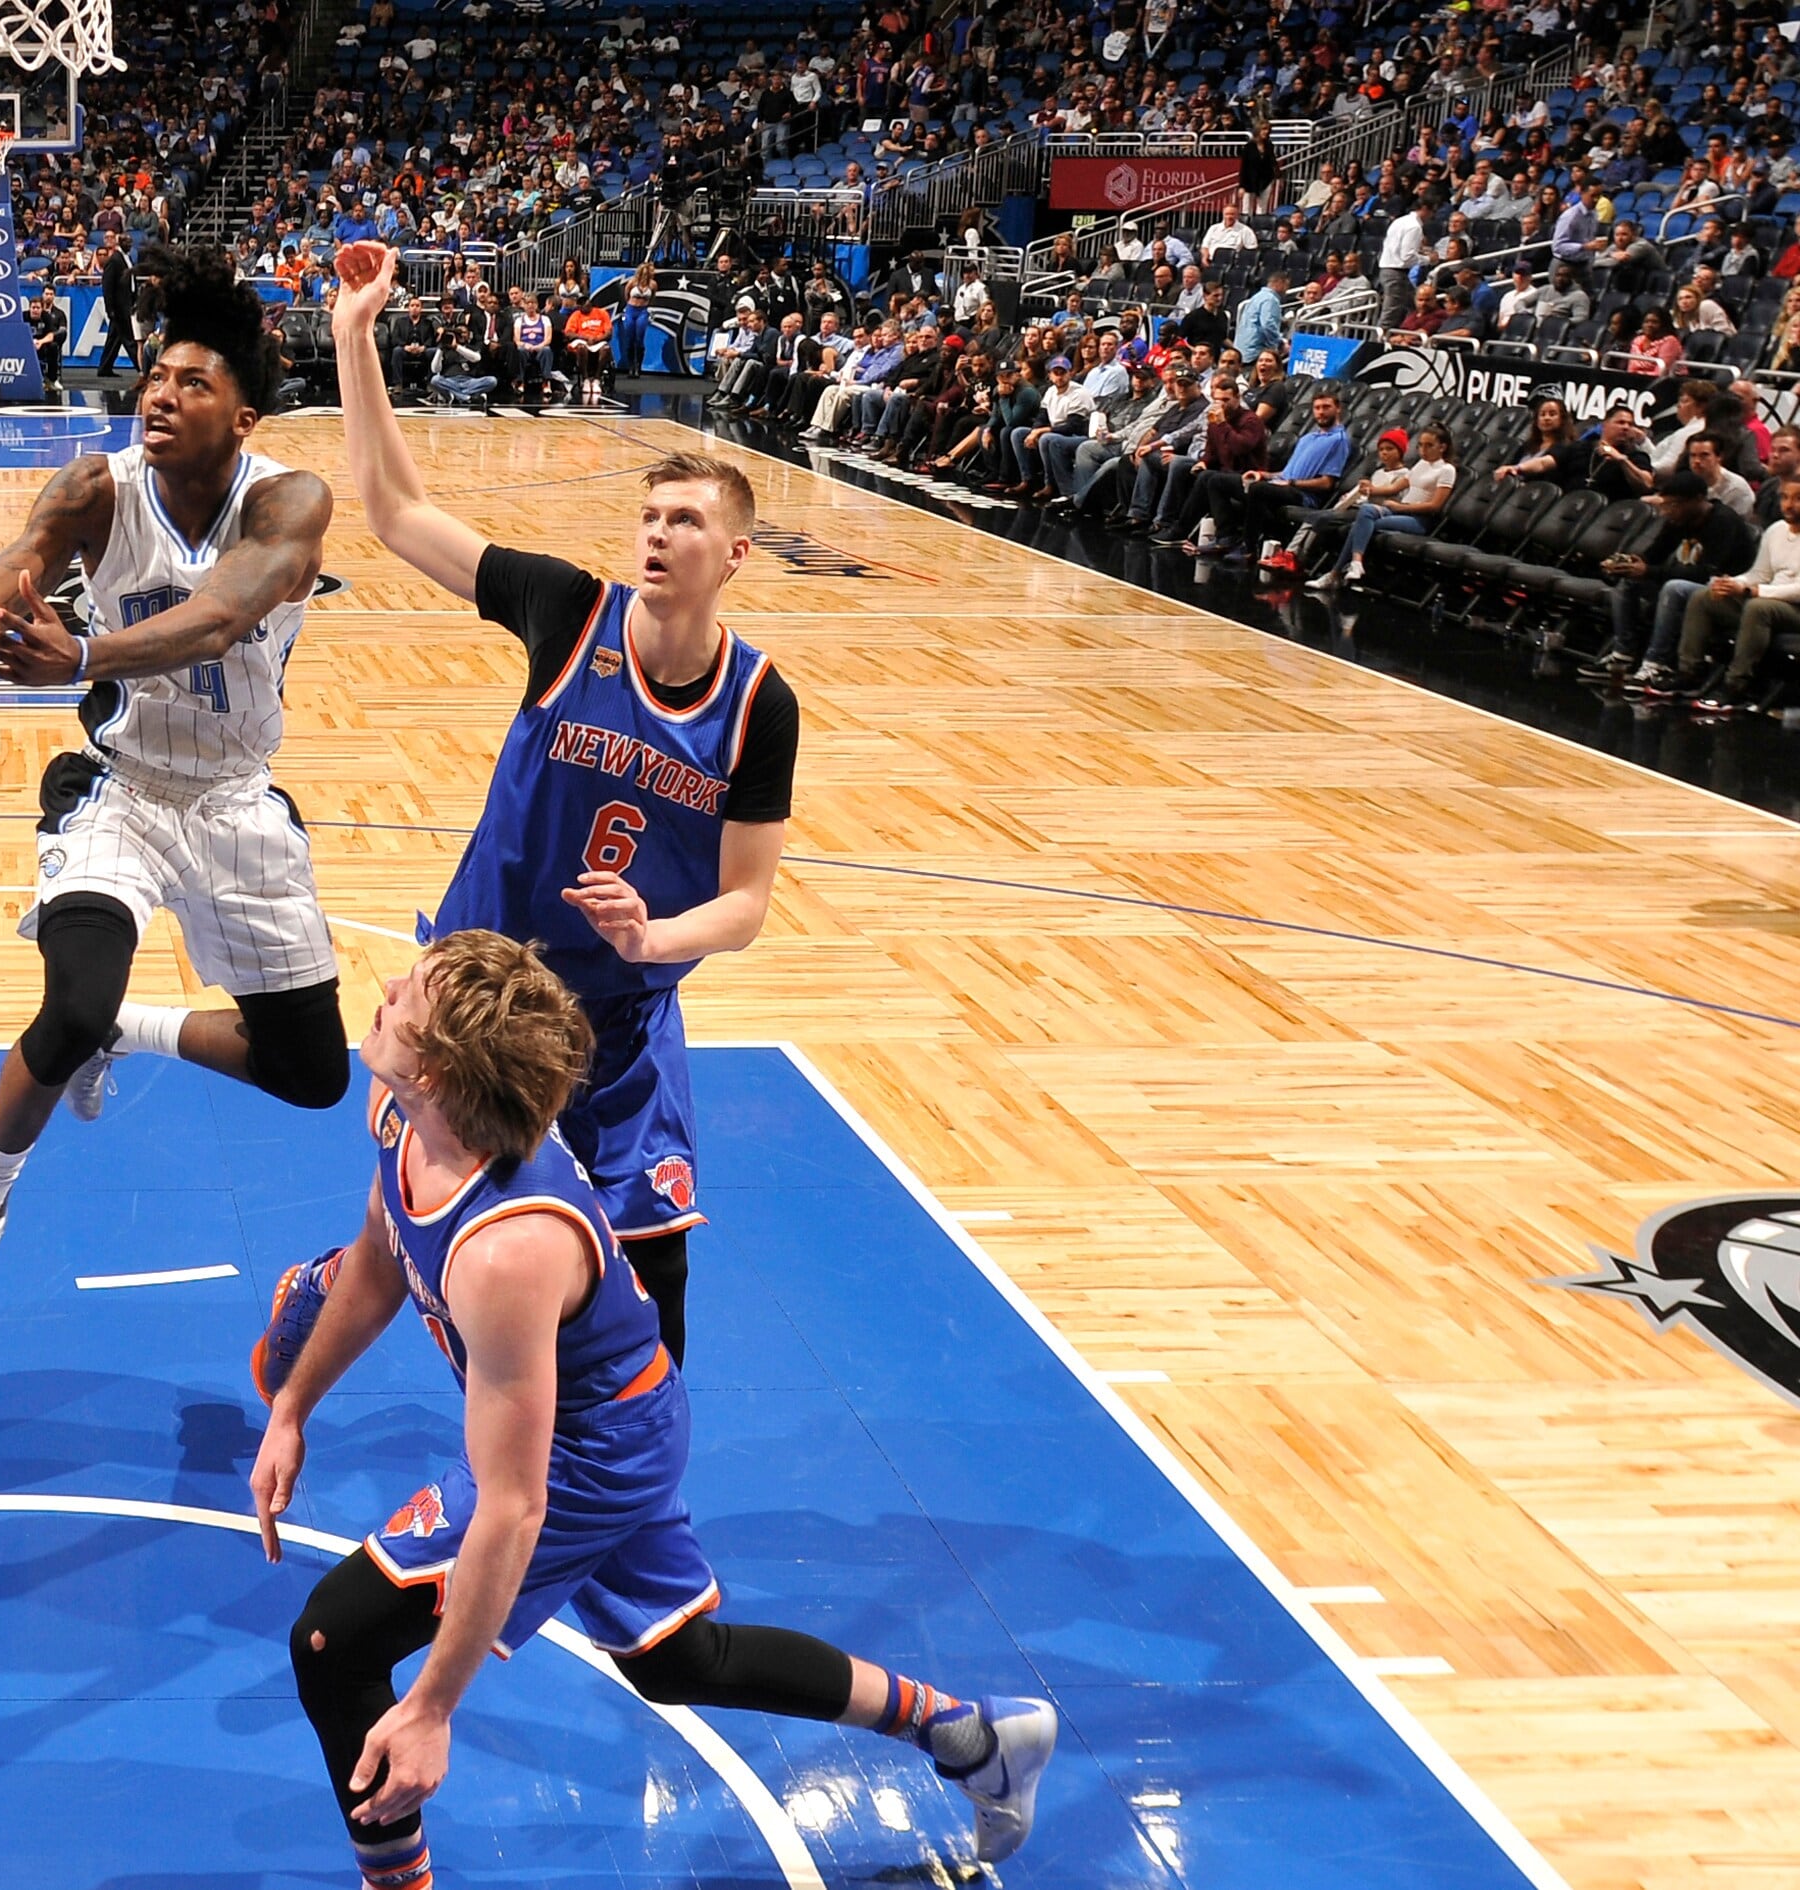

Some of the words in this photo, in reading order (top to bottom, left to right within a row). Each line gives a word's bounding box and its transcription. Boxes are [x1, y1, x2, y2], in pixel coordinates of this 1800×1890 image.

[1142, 169, 1206, 186] FLORIDA
[1466, 370, 1532, 408] PURE
[189, 660, 231, 713] 4
[549, 720, 643, 778] NEW
[635, 743, 731, 817] YORK
[581, 799, 648, 877] 6
